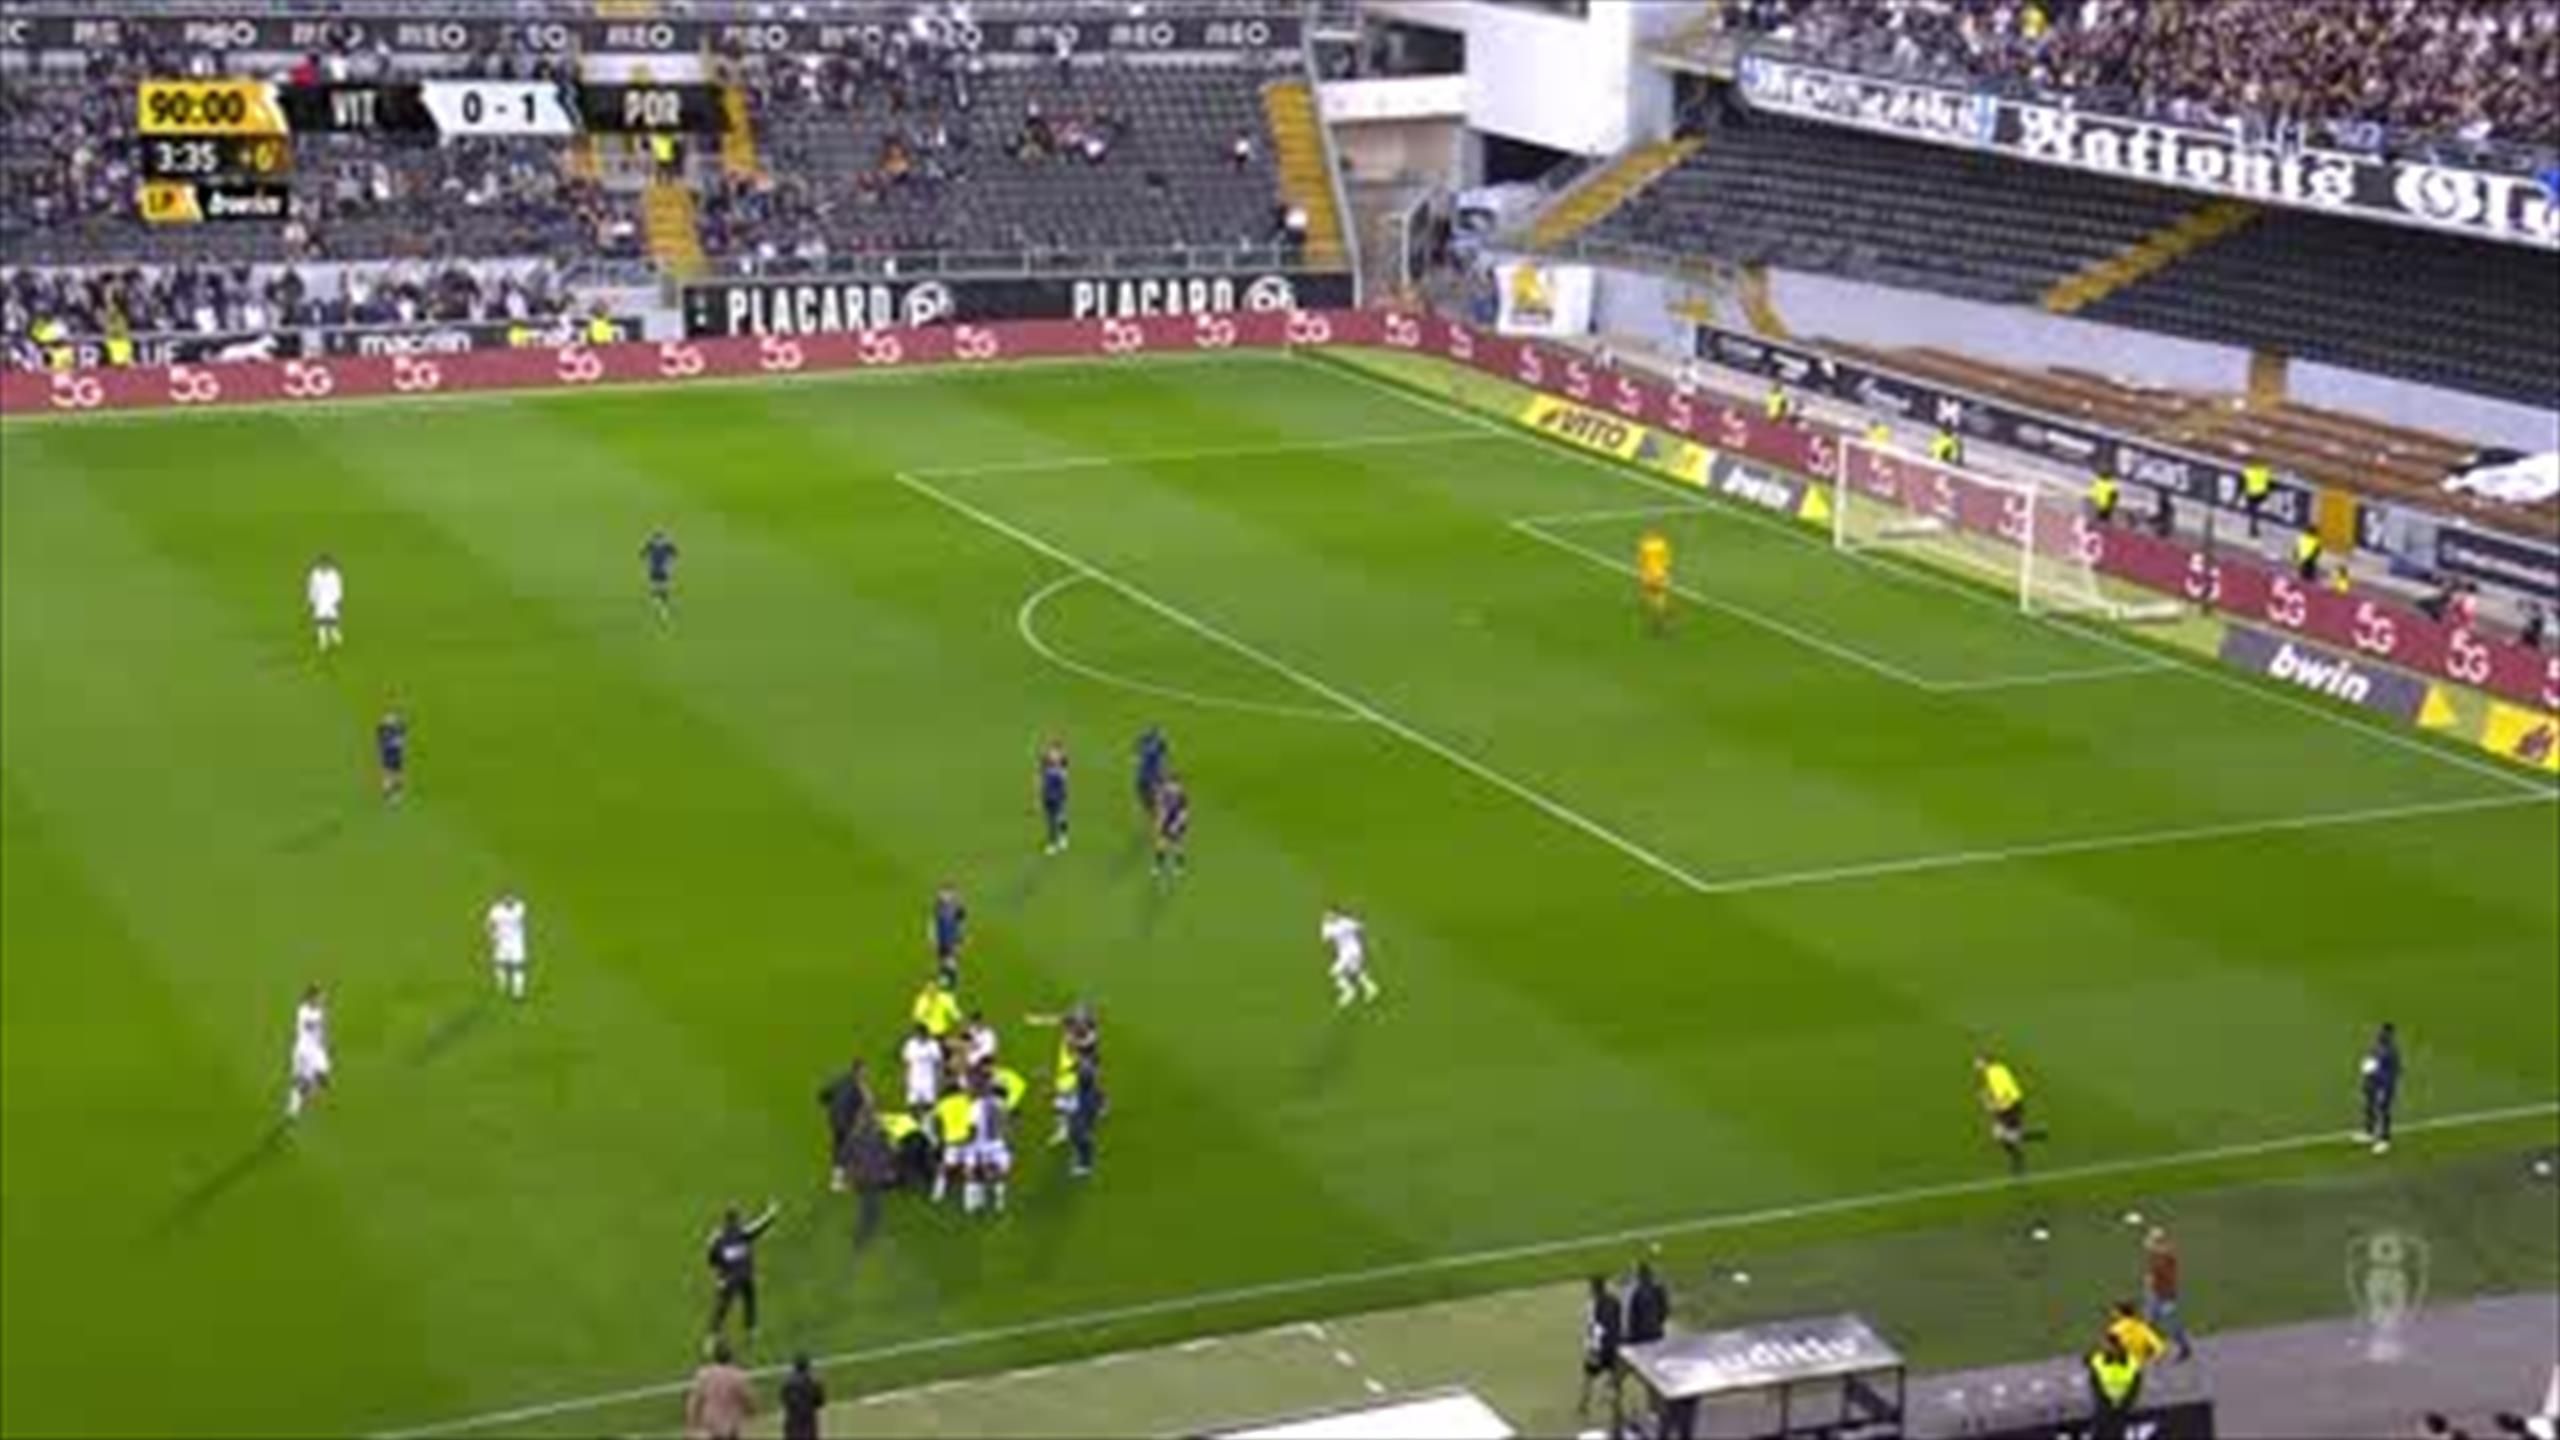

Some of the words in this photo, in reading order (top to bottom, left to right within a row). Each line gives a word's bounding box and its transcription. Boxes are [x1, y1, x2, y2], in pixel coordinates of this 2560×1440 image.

[727, 284, 892, 337] PLACARD
[1286, 309, 1330, 343] 5G
[858, 330, 902, 363] 5G
[953, 325, 997, 359] 5G
[1102, 318, 1142, 351] 5G
[1195, 313, 1236, 347] 5G
[557, 346, 603, 381] 5G
[659, 342, 705, 376] 5G
[759, 336, 803, 369] 5G
[52, 373, 103, 406] 5G
[170, 364, 220, 400] 5G
[284, 361, 333, 396] 5G
[394, 355, 439, 390] 5G
[2267, 575, 2305, 627] 5G
[2353, 602, 2396, 654] 5G
[2447, 629, 2490, 684] 5G
[2269, 643, 2371, 706] bwin
